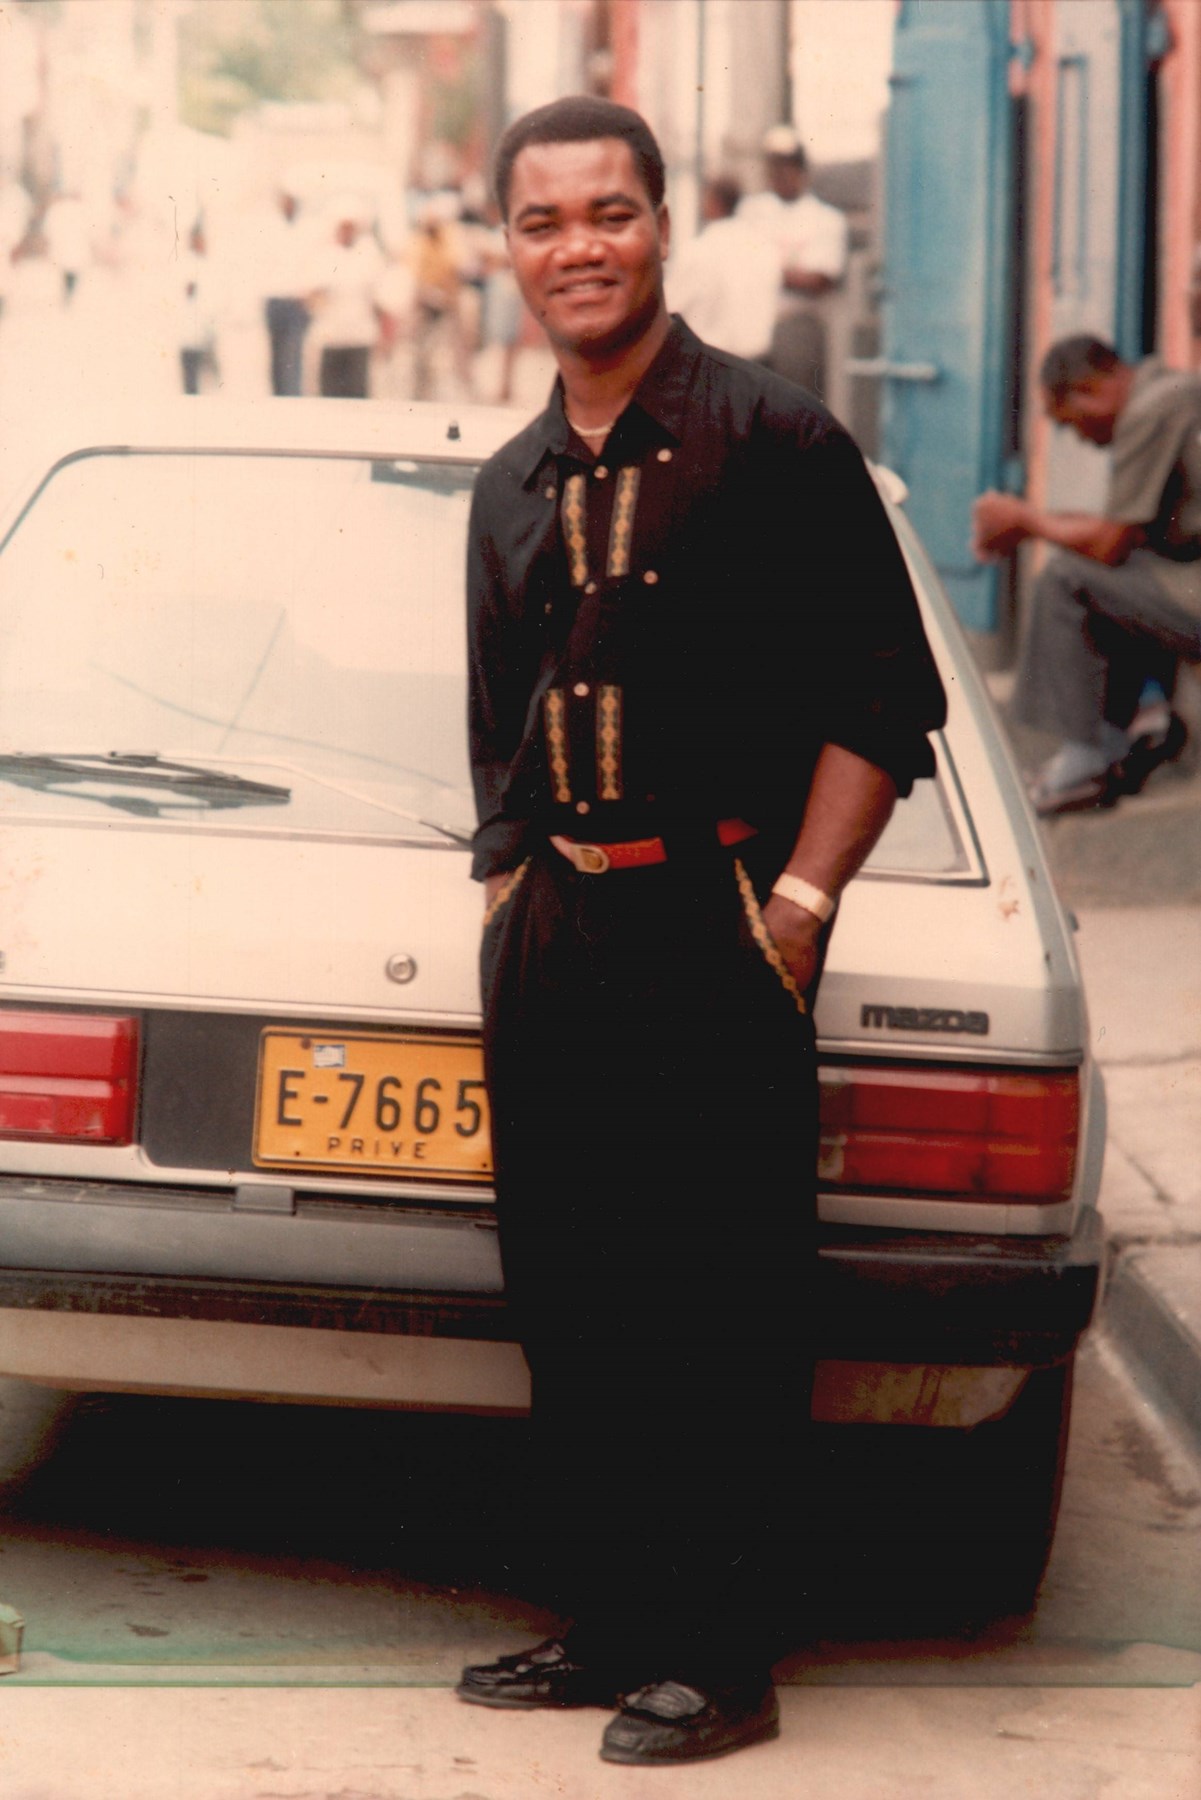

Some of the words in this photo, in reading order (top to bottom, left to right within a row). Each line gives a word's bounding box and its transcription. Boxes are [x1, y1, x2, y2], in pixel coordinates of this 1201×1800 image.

[860, 1004, 990, 1036] mazda
[277, 1069, 486, 1138] E-7665
[327, 1136, 427, 1160] PRIVE
